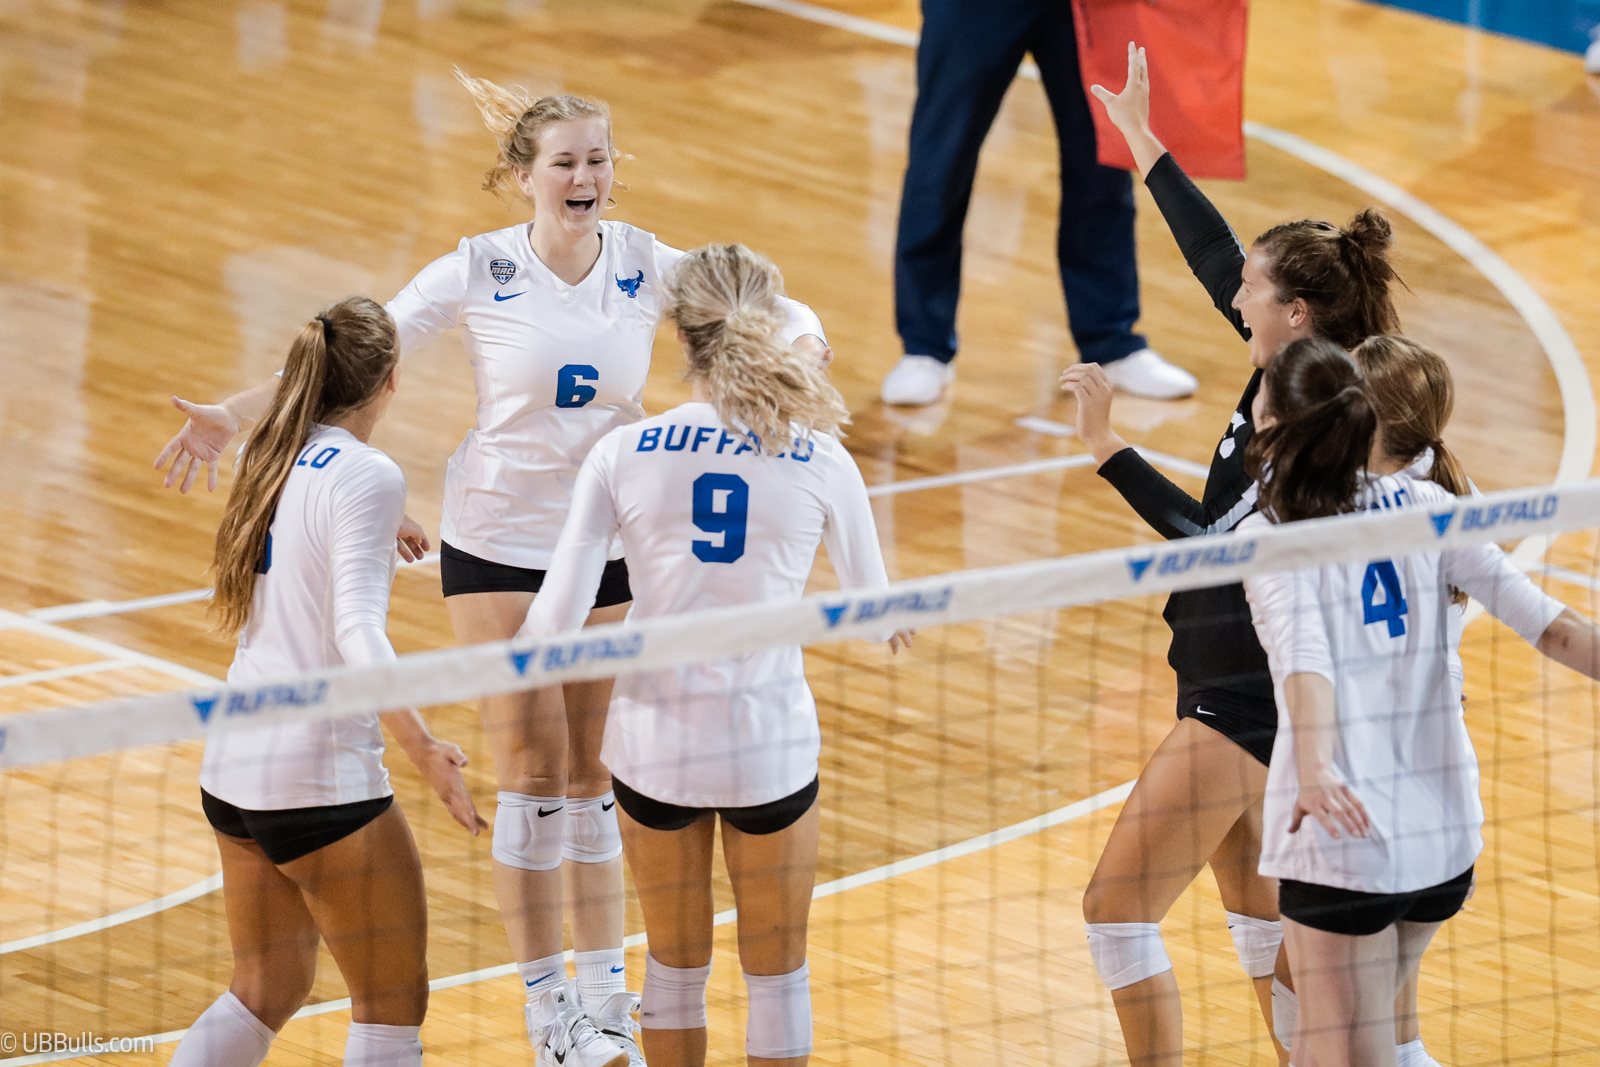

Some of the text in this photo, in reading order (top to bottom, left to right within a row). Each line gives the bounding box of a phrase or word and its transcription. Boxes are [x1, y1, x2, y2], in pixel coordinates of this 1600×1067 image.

[555, 364, 599, 408] 6
[636, 425, 814, 463] BUFFAO
[692, 472, 749, 564] 9
[1460, 494, 1558, 532] BUFFALO
[1156, 539, 1257, 575] BUFFALO
[1361, 560, 1408, 638] 4
